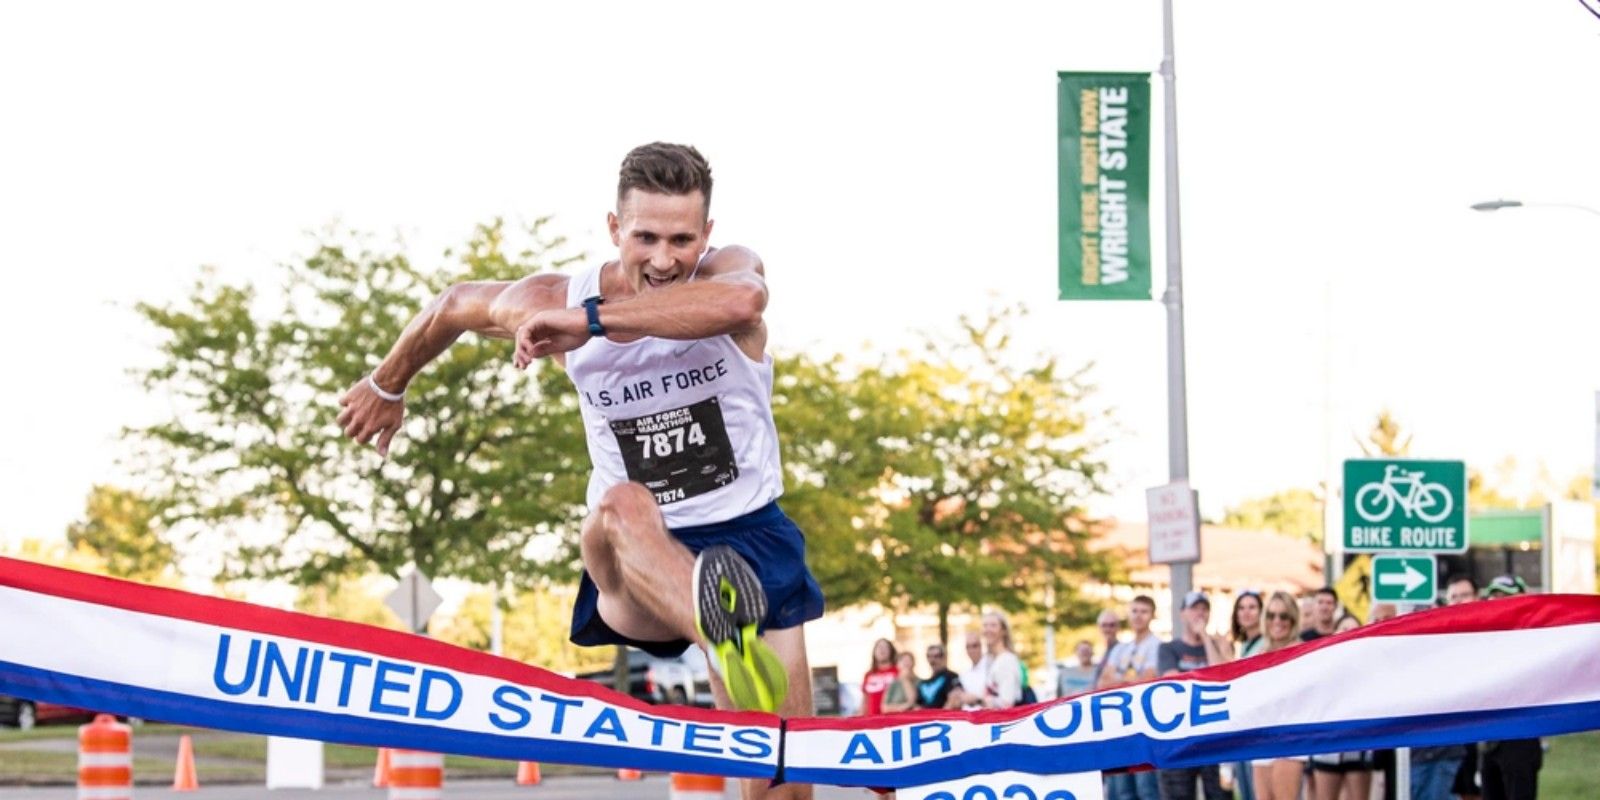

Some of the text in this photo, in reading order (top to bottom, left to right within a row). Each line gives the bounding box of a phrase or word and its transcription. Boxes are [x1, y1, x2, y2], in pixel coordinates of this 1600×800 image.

[1100, 86, 1128, 285] WRIGHT STATE
[623, 381, 654, 403] AIR
[662, 358, 728, 394] FORCE
[636, 407, 690, 428] AIR FORCE
[637, 414, 693, 433] MARATHON
[635, 422, 706, 459] 7874
[655, 487, 685, 504] 7874
[1351, 526, 1457, 548] BIKE ROUTE
[213, 633, 773, 759] UNITED STATES
[839, 722, 952, 765] AIR
